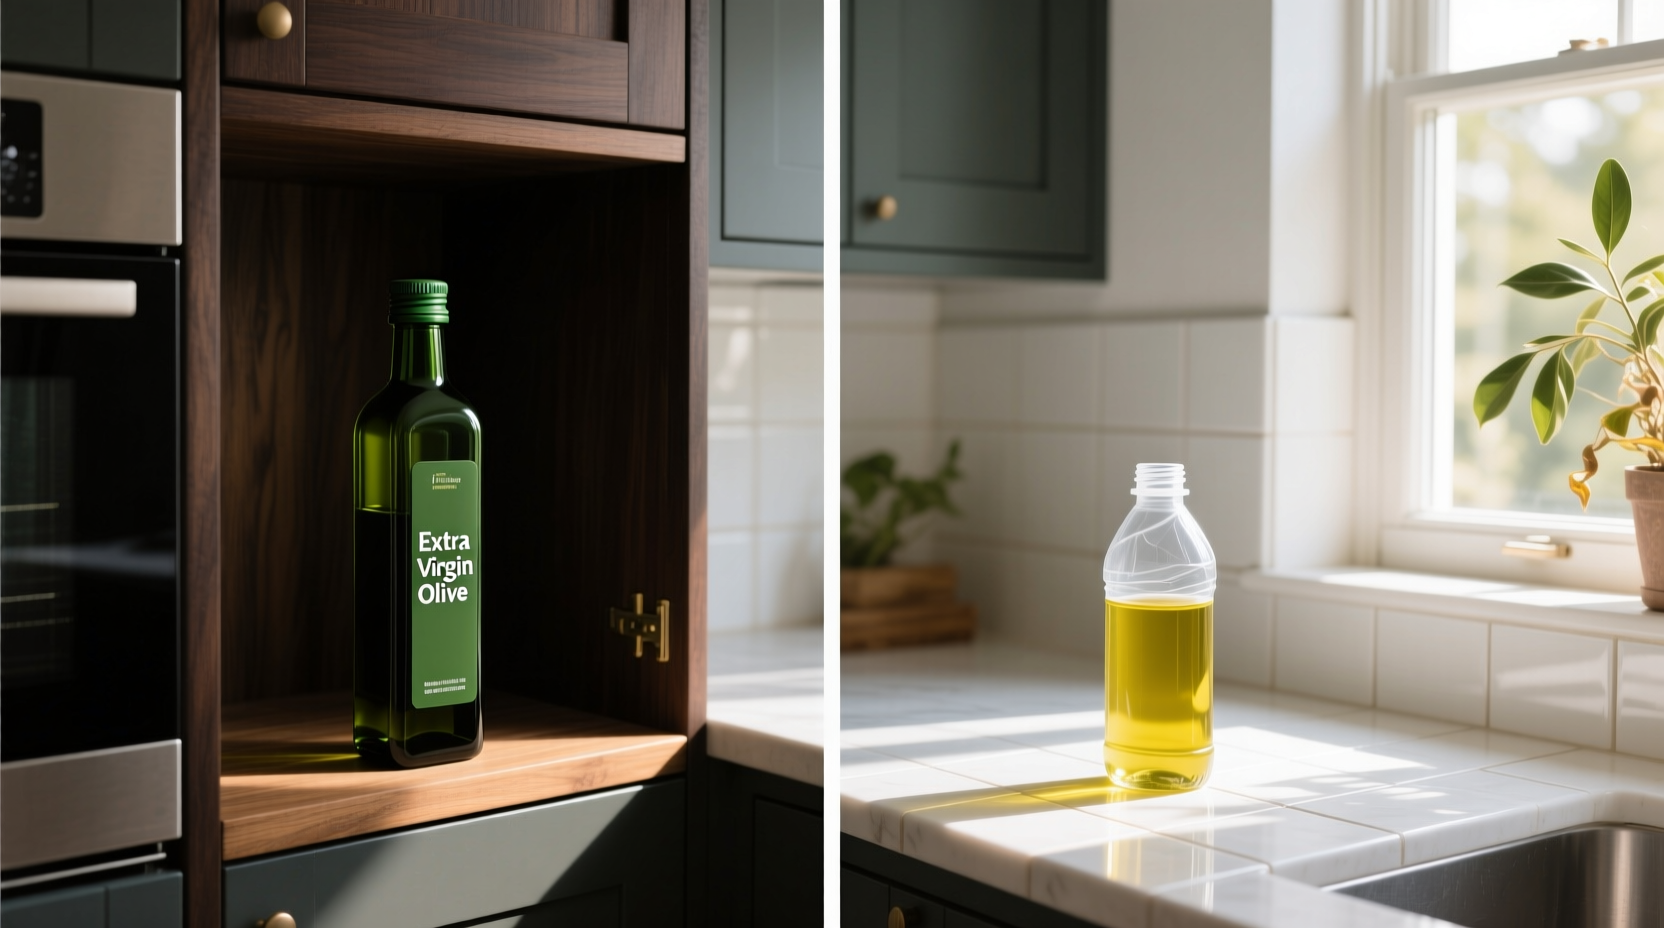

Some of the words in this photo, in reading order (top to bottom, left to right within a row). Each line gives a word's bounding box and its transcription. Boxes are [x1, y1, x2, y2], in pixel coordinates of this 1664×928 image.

[418, 531, 471, 553] Extra
[416, 556, 474, 583] Virgin
[417, 583, 469, 605] Olive
